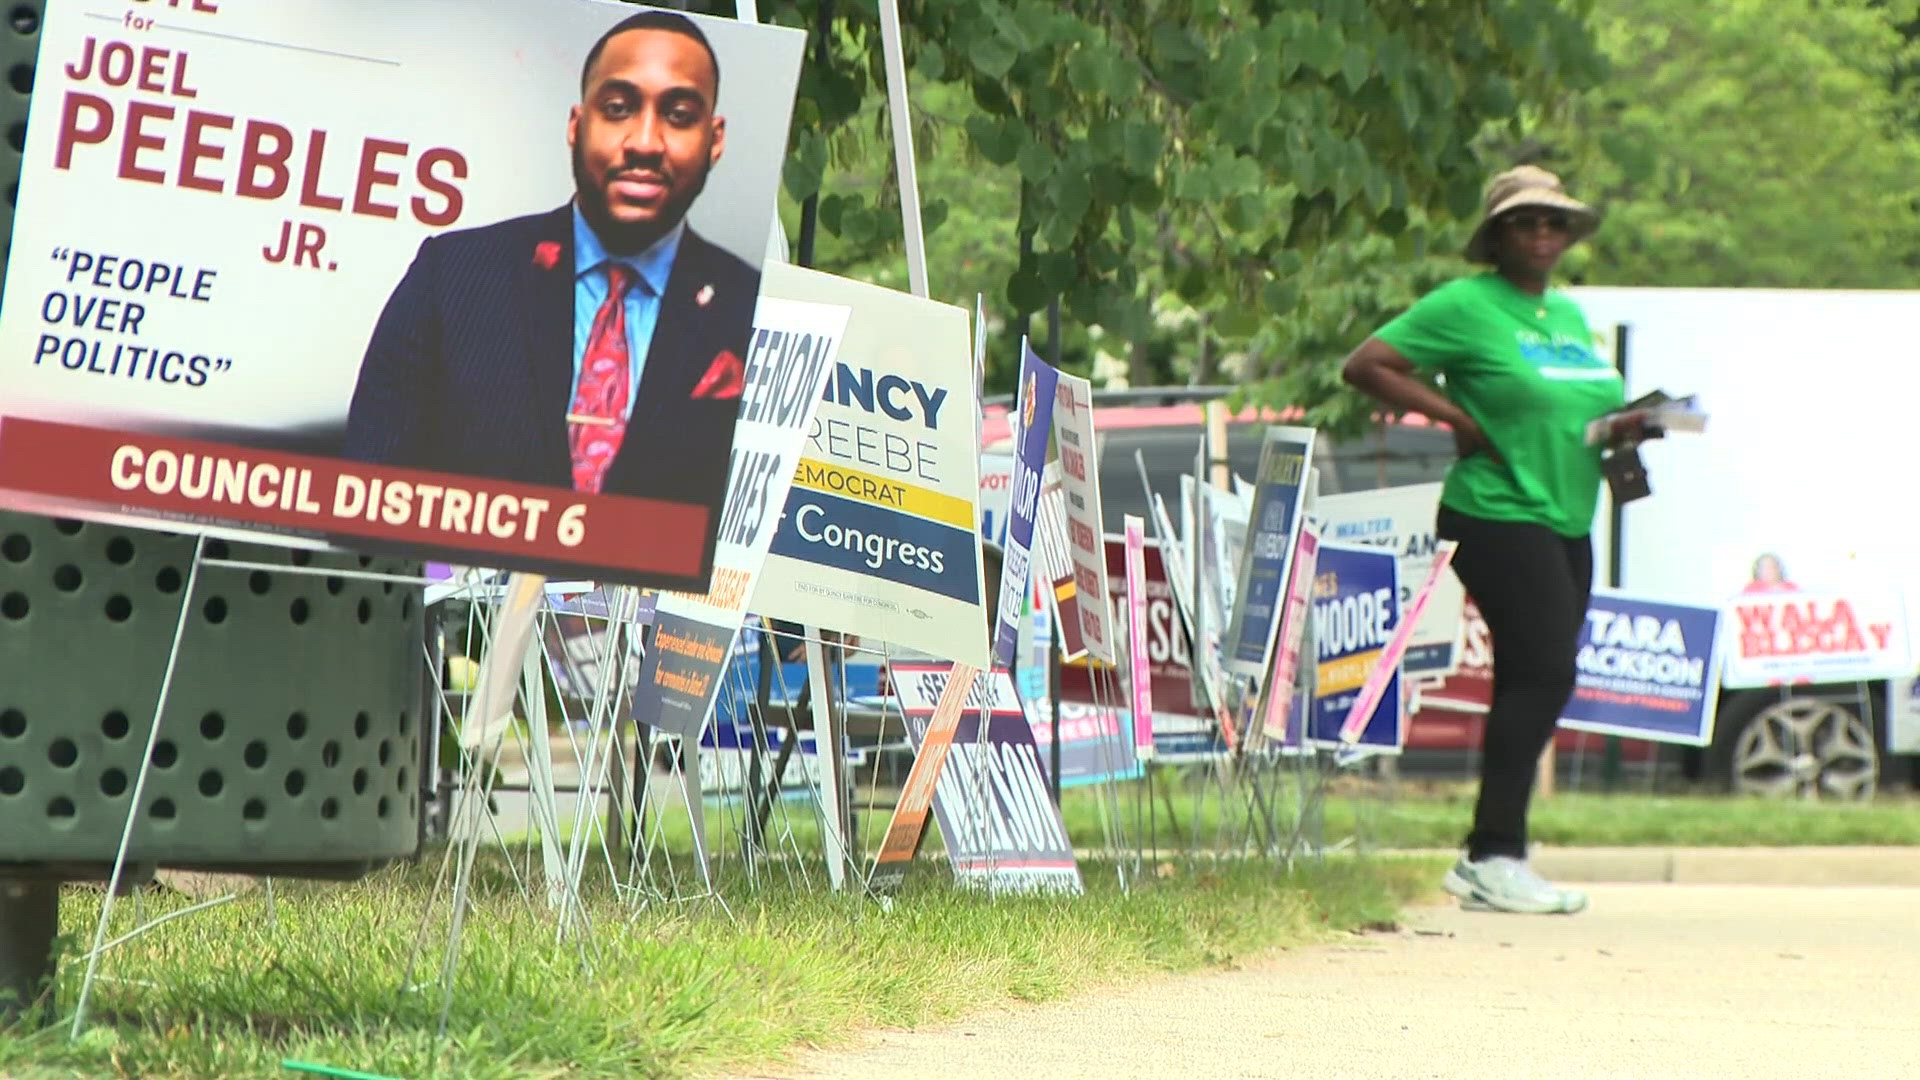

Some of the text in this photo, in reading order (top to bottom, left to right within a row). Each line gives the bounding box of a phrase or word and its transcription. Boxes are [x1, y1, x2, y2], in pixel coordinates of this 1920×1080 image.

[124, 10, 155, 31] for
[64, 36, 198, 98] JOEL
[53, 90, 469, 227] PEEBLES
[262, 220, 339, 272] JR.
[50, 247, 217, 302] “PEOPLE
[41, 292, 146, 335] OVER
[33, 334, 233, 387] POLITICS”
[736, 327, 832, 429] EENON
[808, 416, 940, 482] REEBE
[110, 444, 321, 515] COUNCIL
[332, 473, 550, 542] DISTRICT
[557, 503, 588, 548] 6
[794, 463, 906, 506] EMOCRAT
[795, 503, 944, 574] Congress
[1313, 587, 1394, 658] MOORE
[1586, 607, 1687, 656] TARA
[1575, 643, 1704, 688] ACKSON
